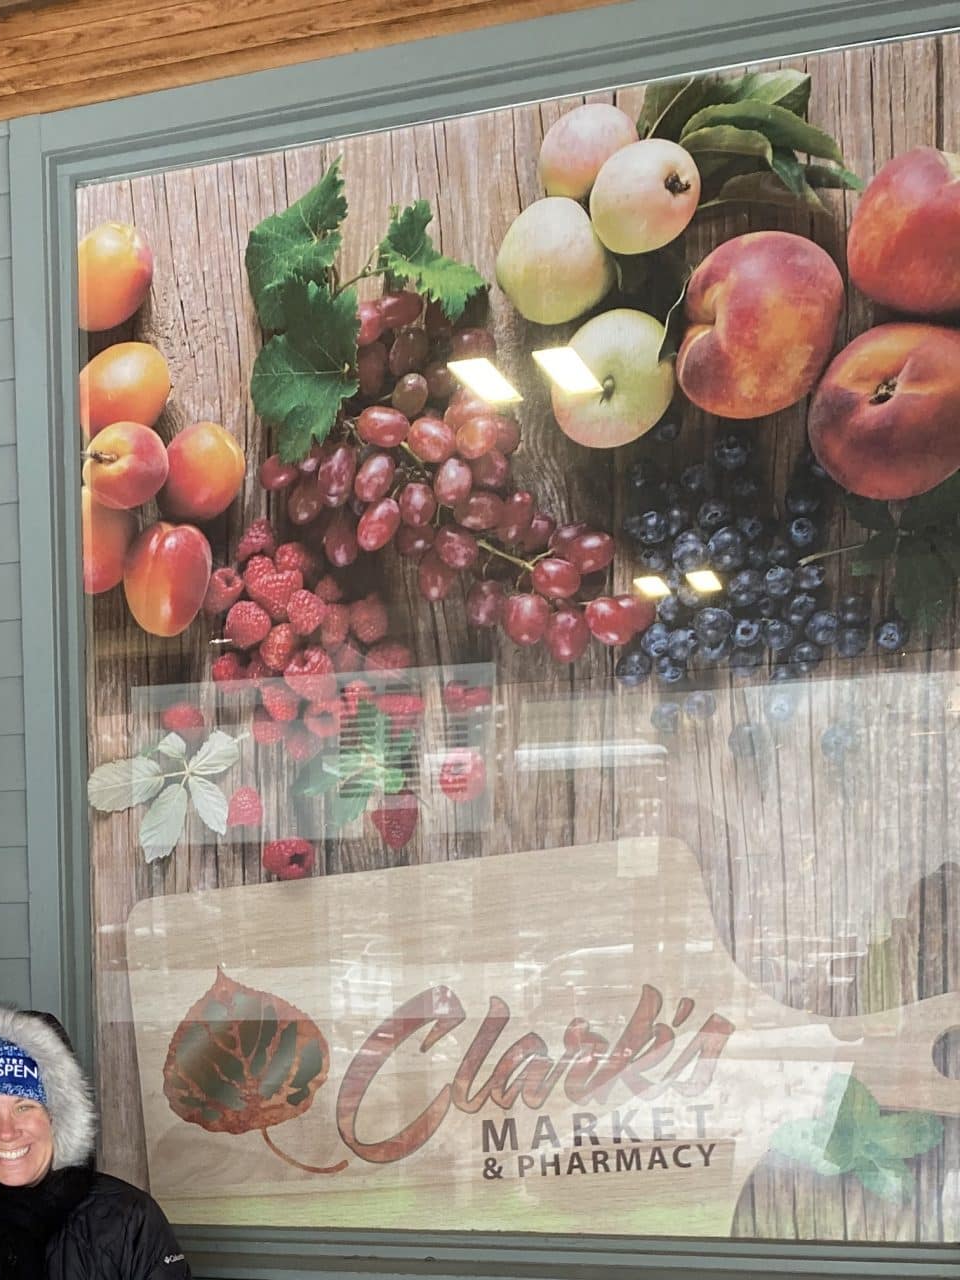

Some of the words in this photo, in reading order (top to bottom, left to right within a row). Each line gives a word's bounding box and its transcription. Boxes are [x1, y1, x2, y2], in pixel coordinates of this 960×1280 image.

[336, 984, 736, 1164] Clark's
[481, 1104, 714, 1153] MARKET
[483, 1157, 503, 1179] &
[518, 1143, 717, 1178] PHARMACY
